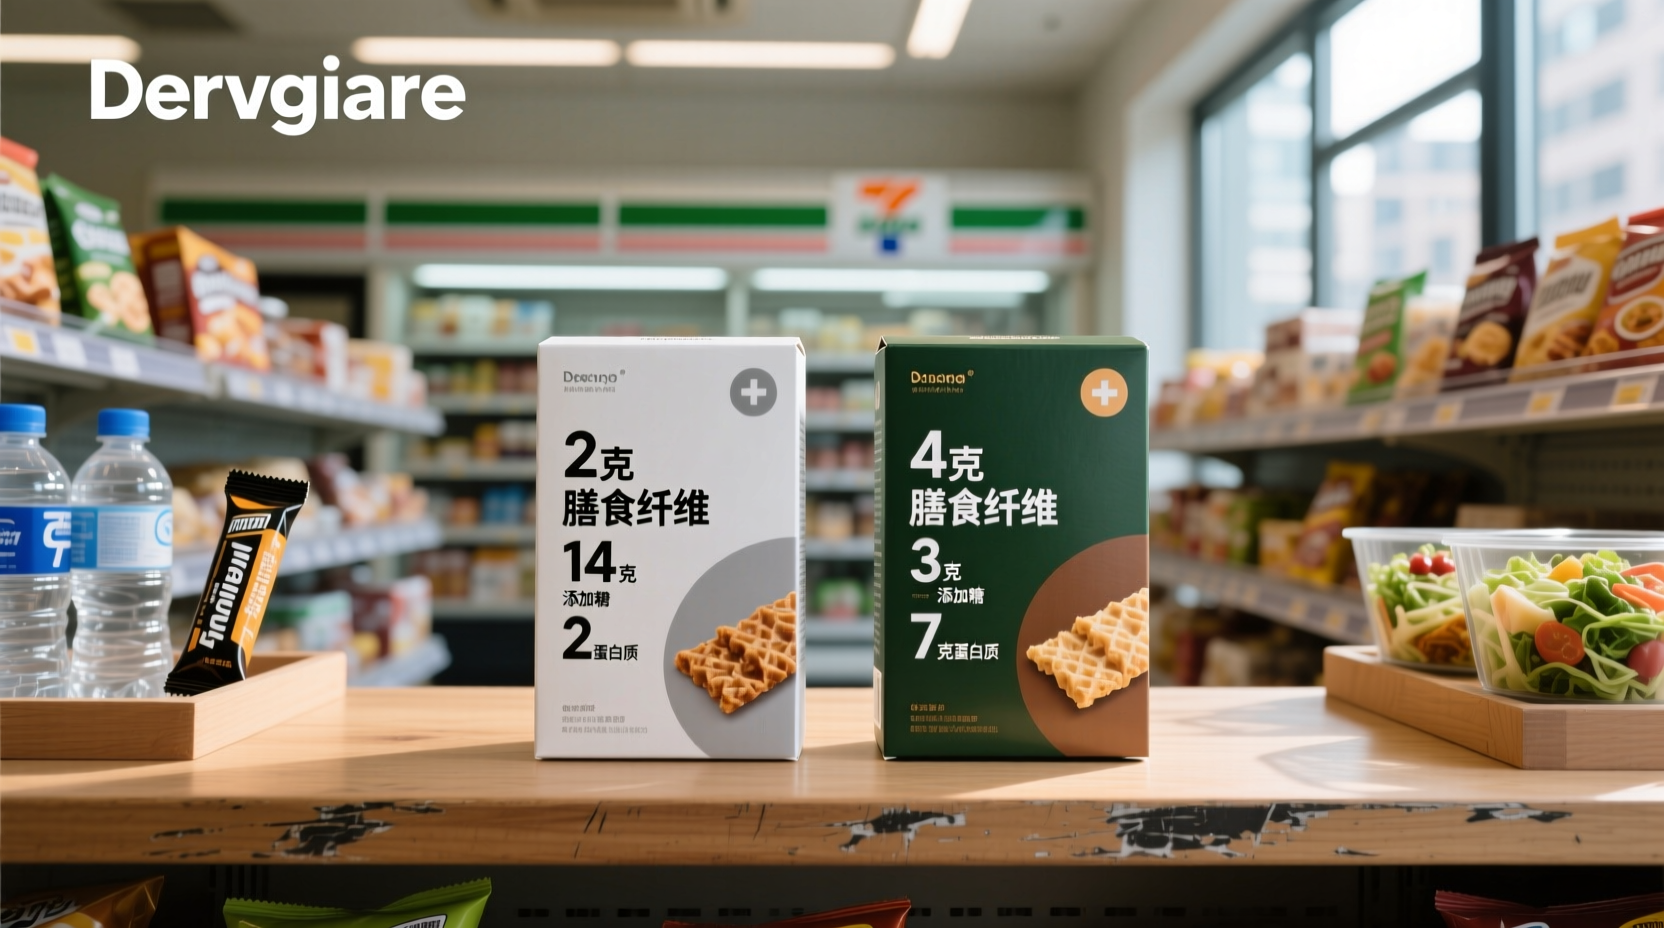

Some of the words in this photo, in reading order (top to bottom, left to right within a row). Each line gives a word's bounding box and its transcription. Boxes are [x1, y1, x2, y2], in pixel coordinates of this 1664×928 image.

[564, 430, 635, 482] 2克
[910, 430, 985, 482] 4克
[562, 488, 710, 527] 膳食纤维
[909, 487, 1059, 527] 膳食纤维
[563, 540, 637, 583] 14克
[910, 537, 962, 583] 3克
